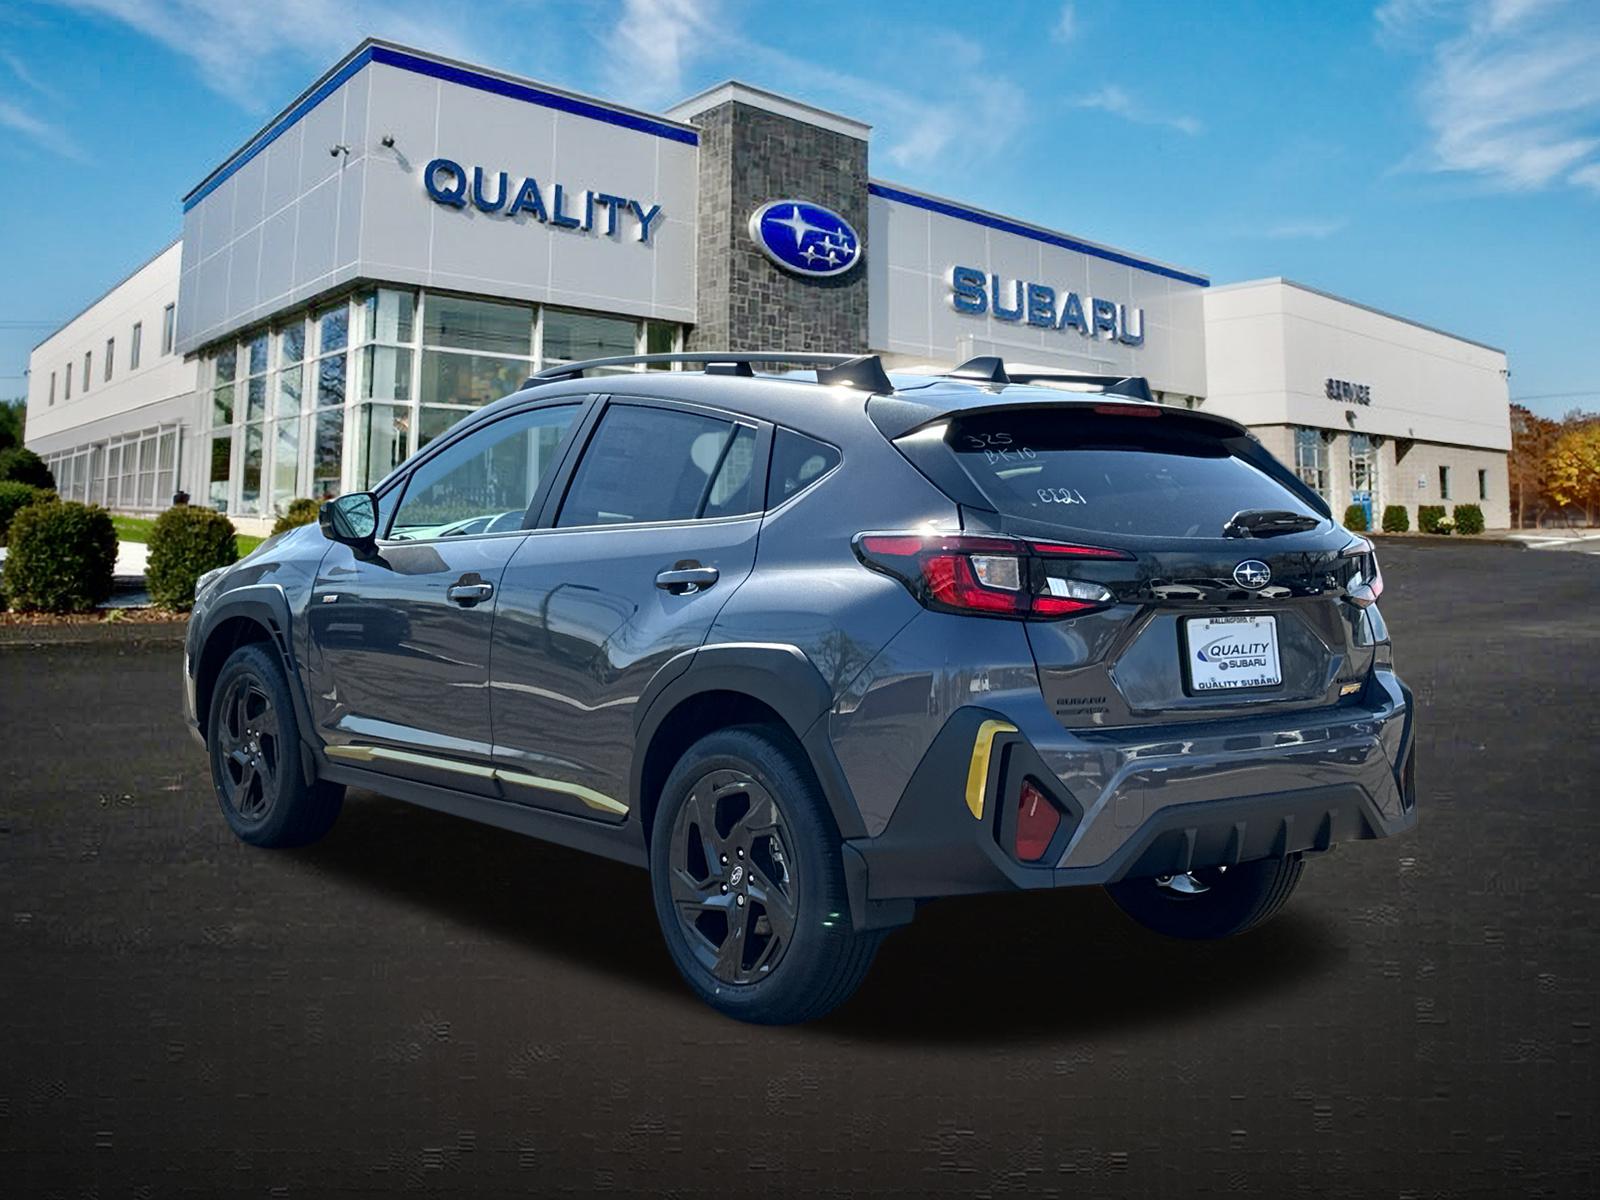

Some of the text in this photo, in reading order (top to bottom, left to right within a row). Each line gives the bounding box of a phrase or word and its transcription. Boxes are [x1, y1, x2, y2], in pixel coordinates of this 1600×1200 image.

[424, 159, 661, 242] QUALITY
[951, 265, 1145, 346] SUBARU
[1325, 378, 1371, 406] SERVICE
[1210, 642, 1270, 657] QUALITY
[1229, 658, 1267, 669] SUBARU
[1198, 677, 1280, 689] QUALITY SUBARU
